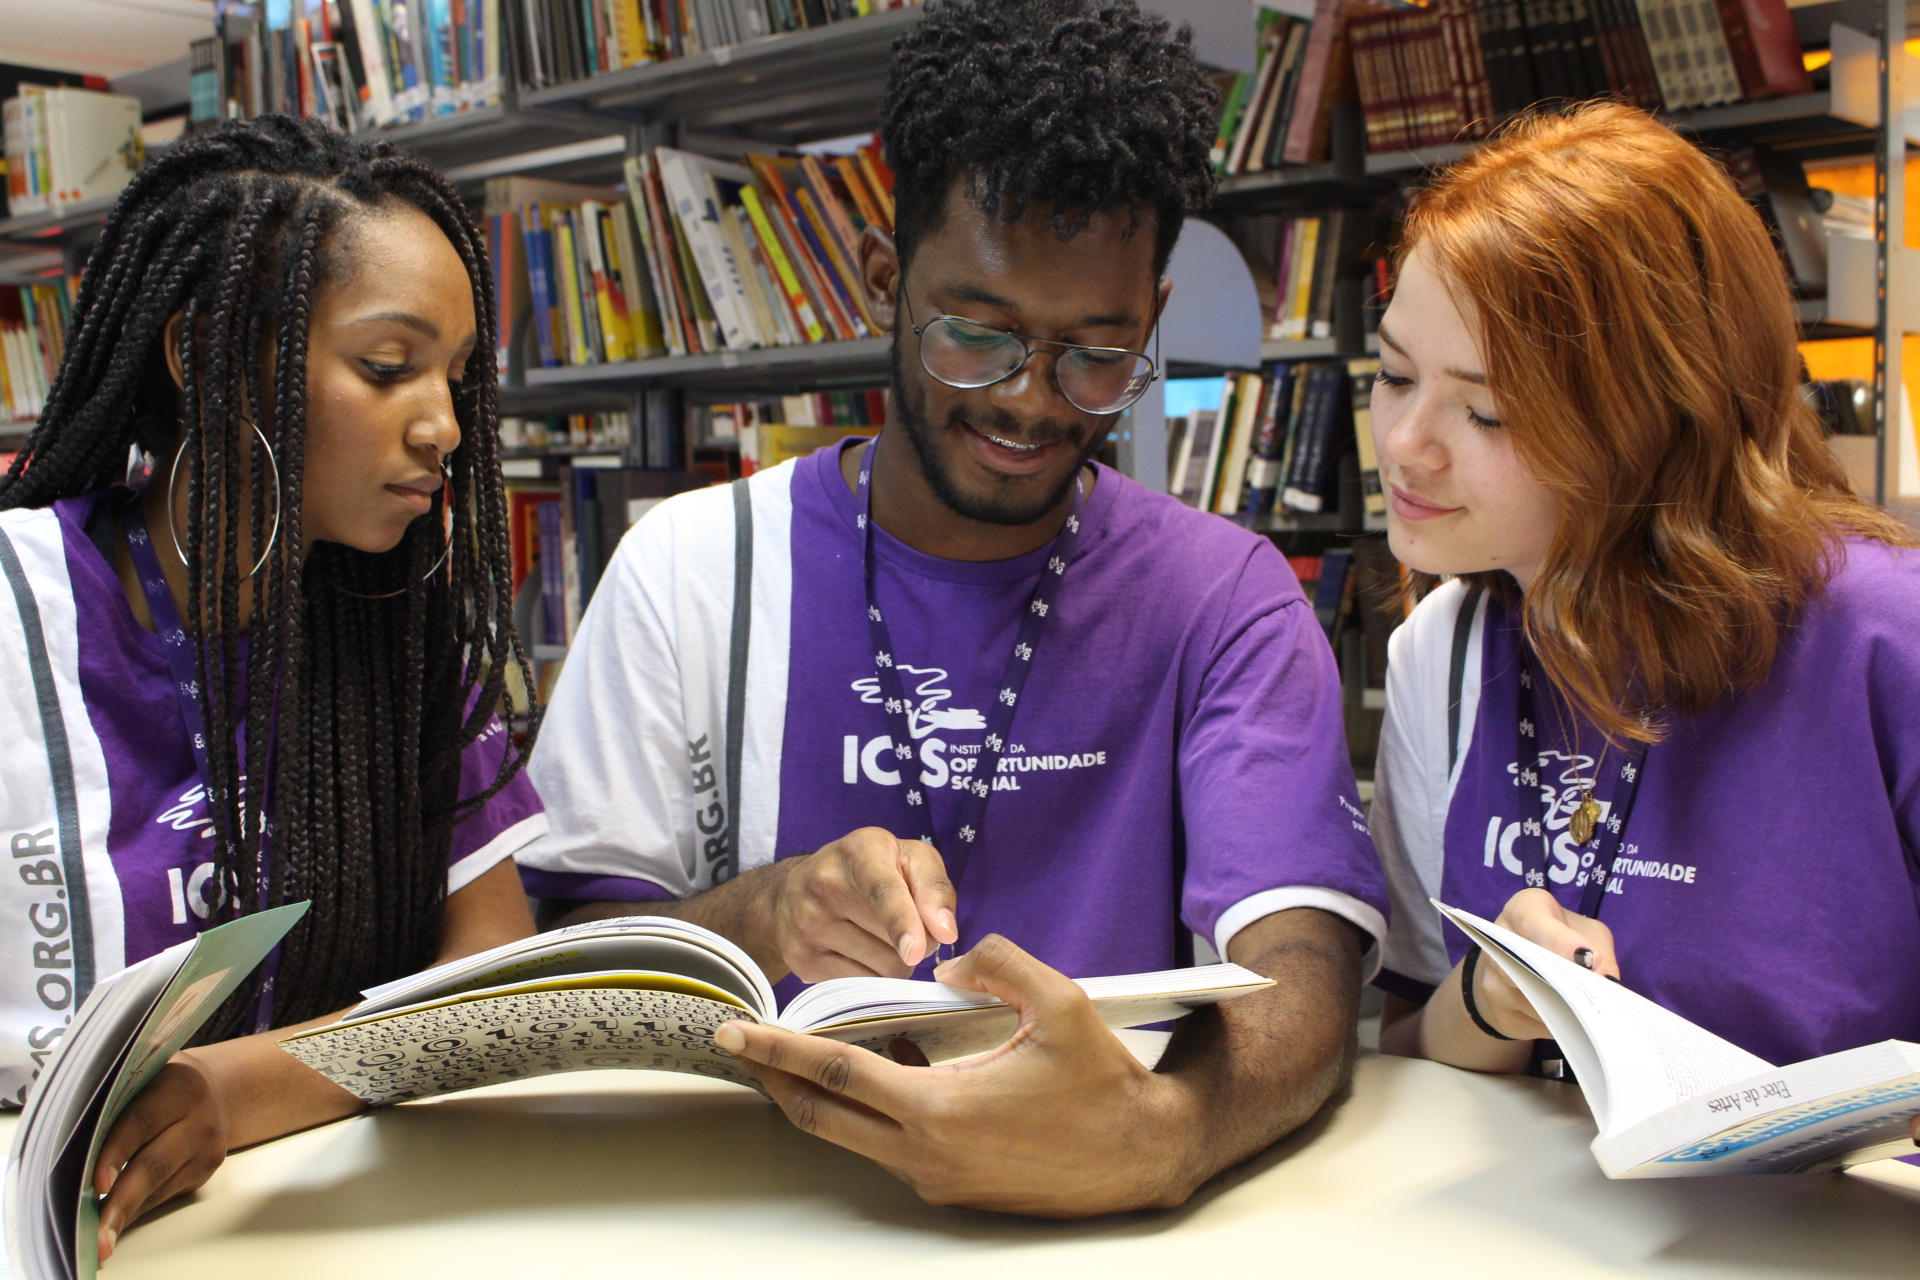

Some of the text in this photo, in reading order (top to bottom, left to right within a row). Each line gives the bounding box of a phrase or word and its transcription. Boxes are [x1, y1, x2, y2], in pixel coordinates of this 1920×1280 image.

[950, 744, 1026, 755] INSTIT DA
[950, 751, 1107, 773] OPRTUNIDADE
[951, 775, 1021, 791] SOIAL
[1626, 843, 1639, 854] DA
[1581, 852, 1697, 884] ORTUNIDADE
[167, 862, 241, 924] IO
[1575, 871, 1623, 894] SIAL
[1708, 1080, 1792, 1113] Etec de Artes
